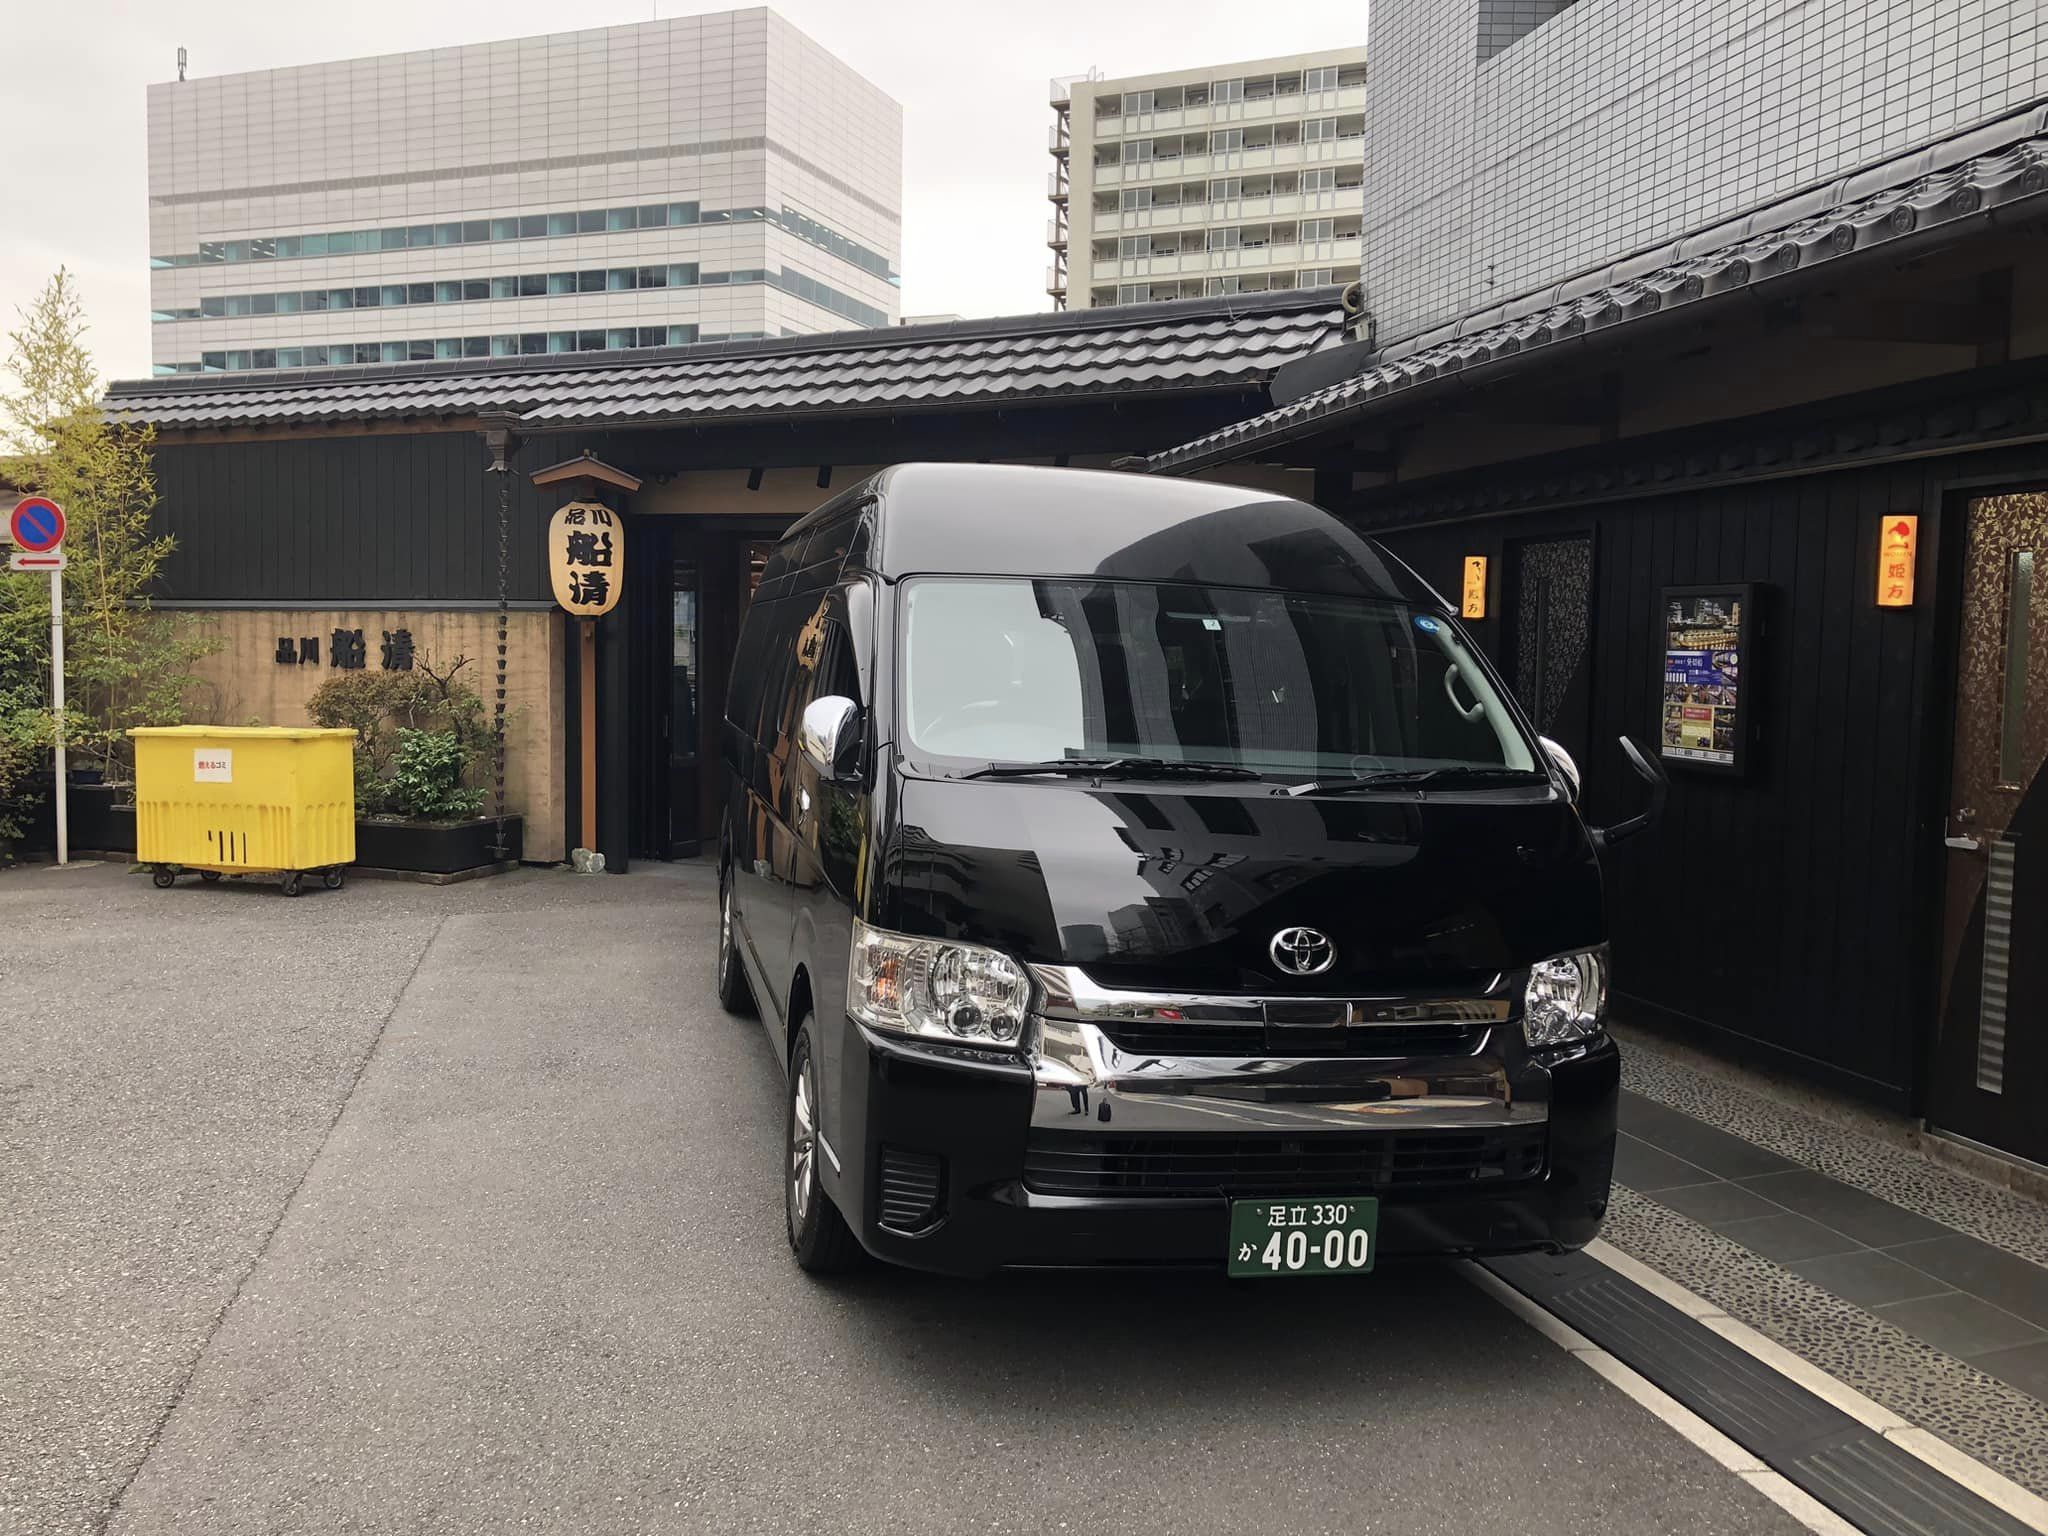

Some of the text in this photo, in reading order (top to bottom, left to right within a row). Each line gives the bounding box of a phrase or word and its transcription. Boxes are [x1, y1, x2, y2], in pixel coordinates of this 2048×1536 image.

[564, 508, 612, 526] 品川
[565, 530, 614, 606] 船清
[1886, 563, 1906, 599] 姫方
[1267, 1204, 1348, 1227] 足立 330
[1237, 1228, 1369, 1271] か 40-00
